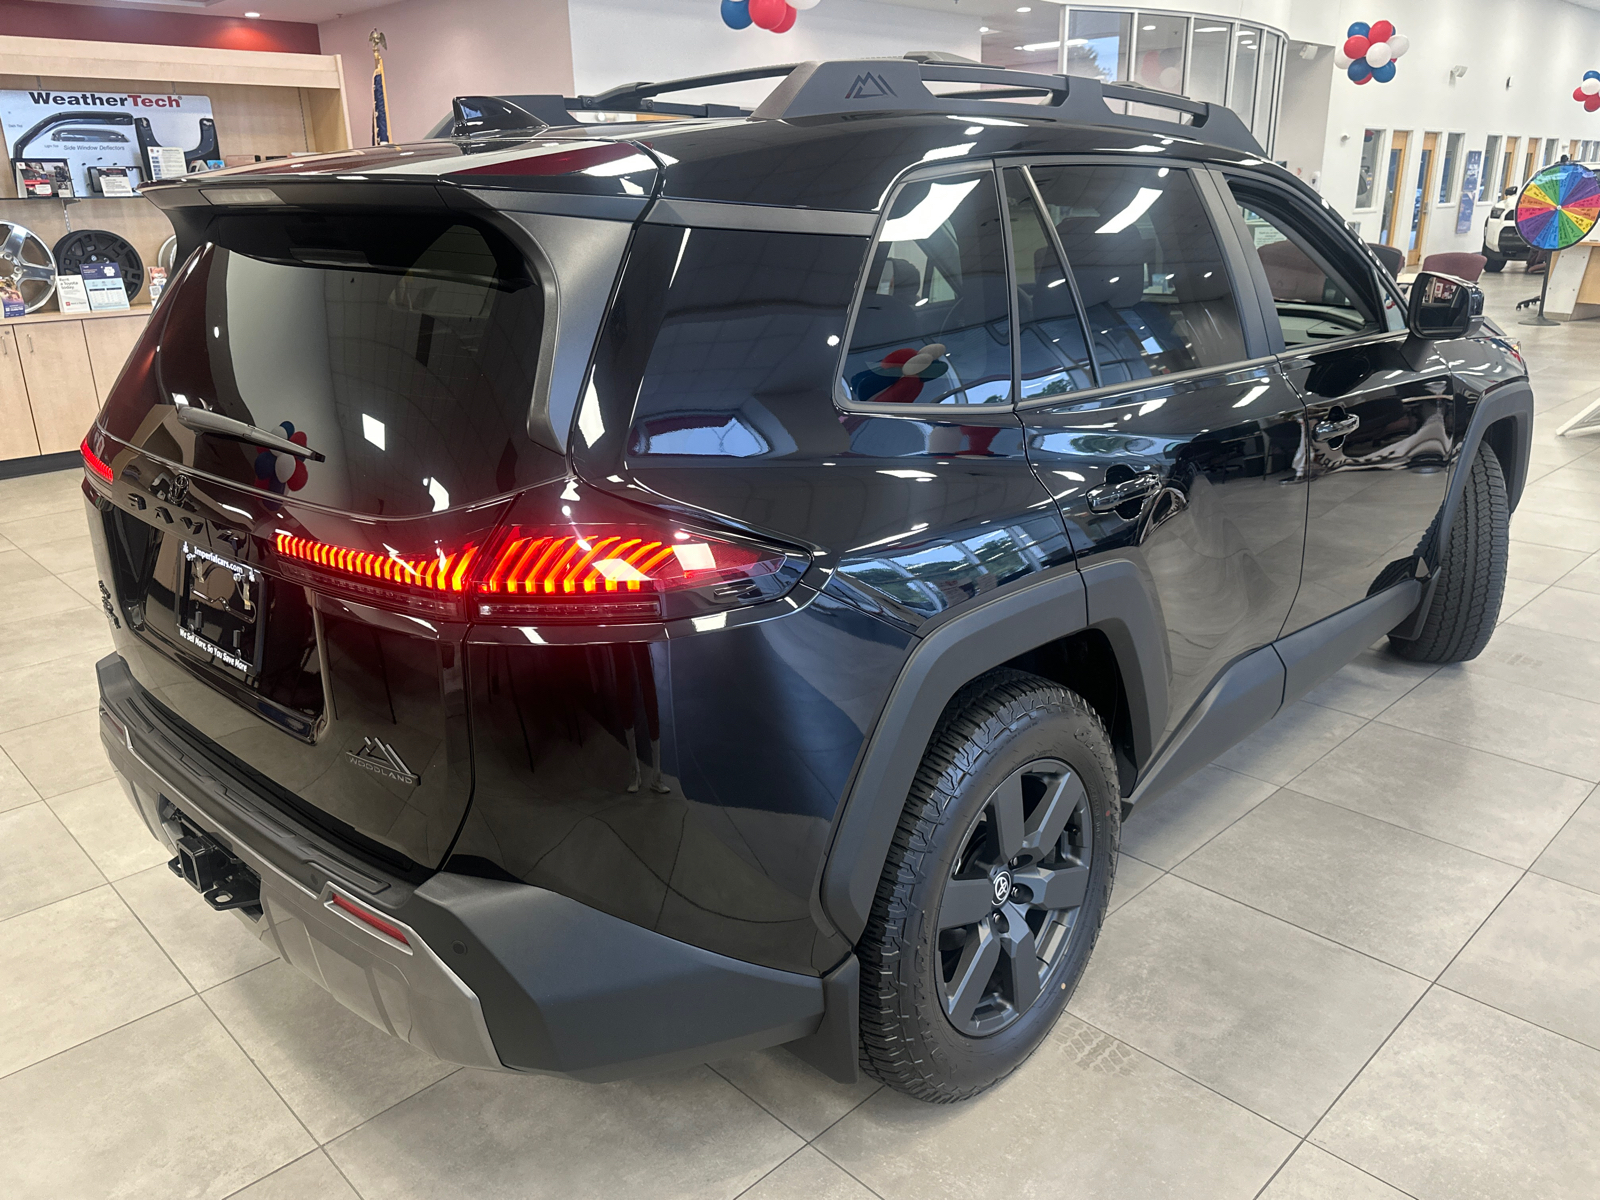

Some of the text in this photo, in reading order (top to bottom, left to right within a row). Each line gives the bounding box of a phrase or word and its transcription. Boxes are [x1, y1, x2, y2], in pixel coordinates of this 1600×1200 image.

[28, 91, 181, 108] WeatherTech
[179, 628, 187, 639] We
[186, 632, 195, 644] Sell
[207, 644, 214, 654] So
[213, 647, 223, 659] You
[222, 652, 235, 666] Save
[234, 658, 248, 673] More
[348, 756, 413, 784] WOODLAND
